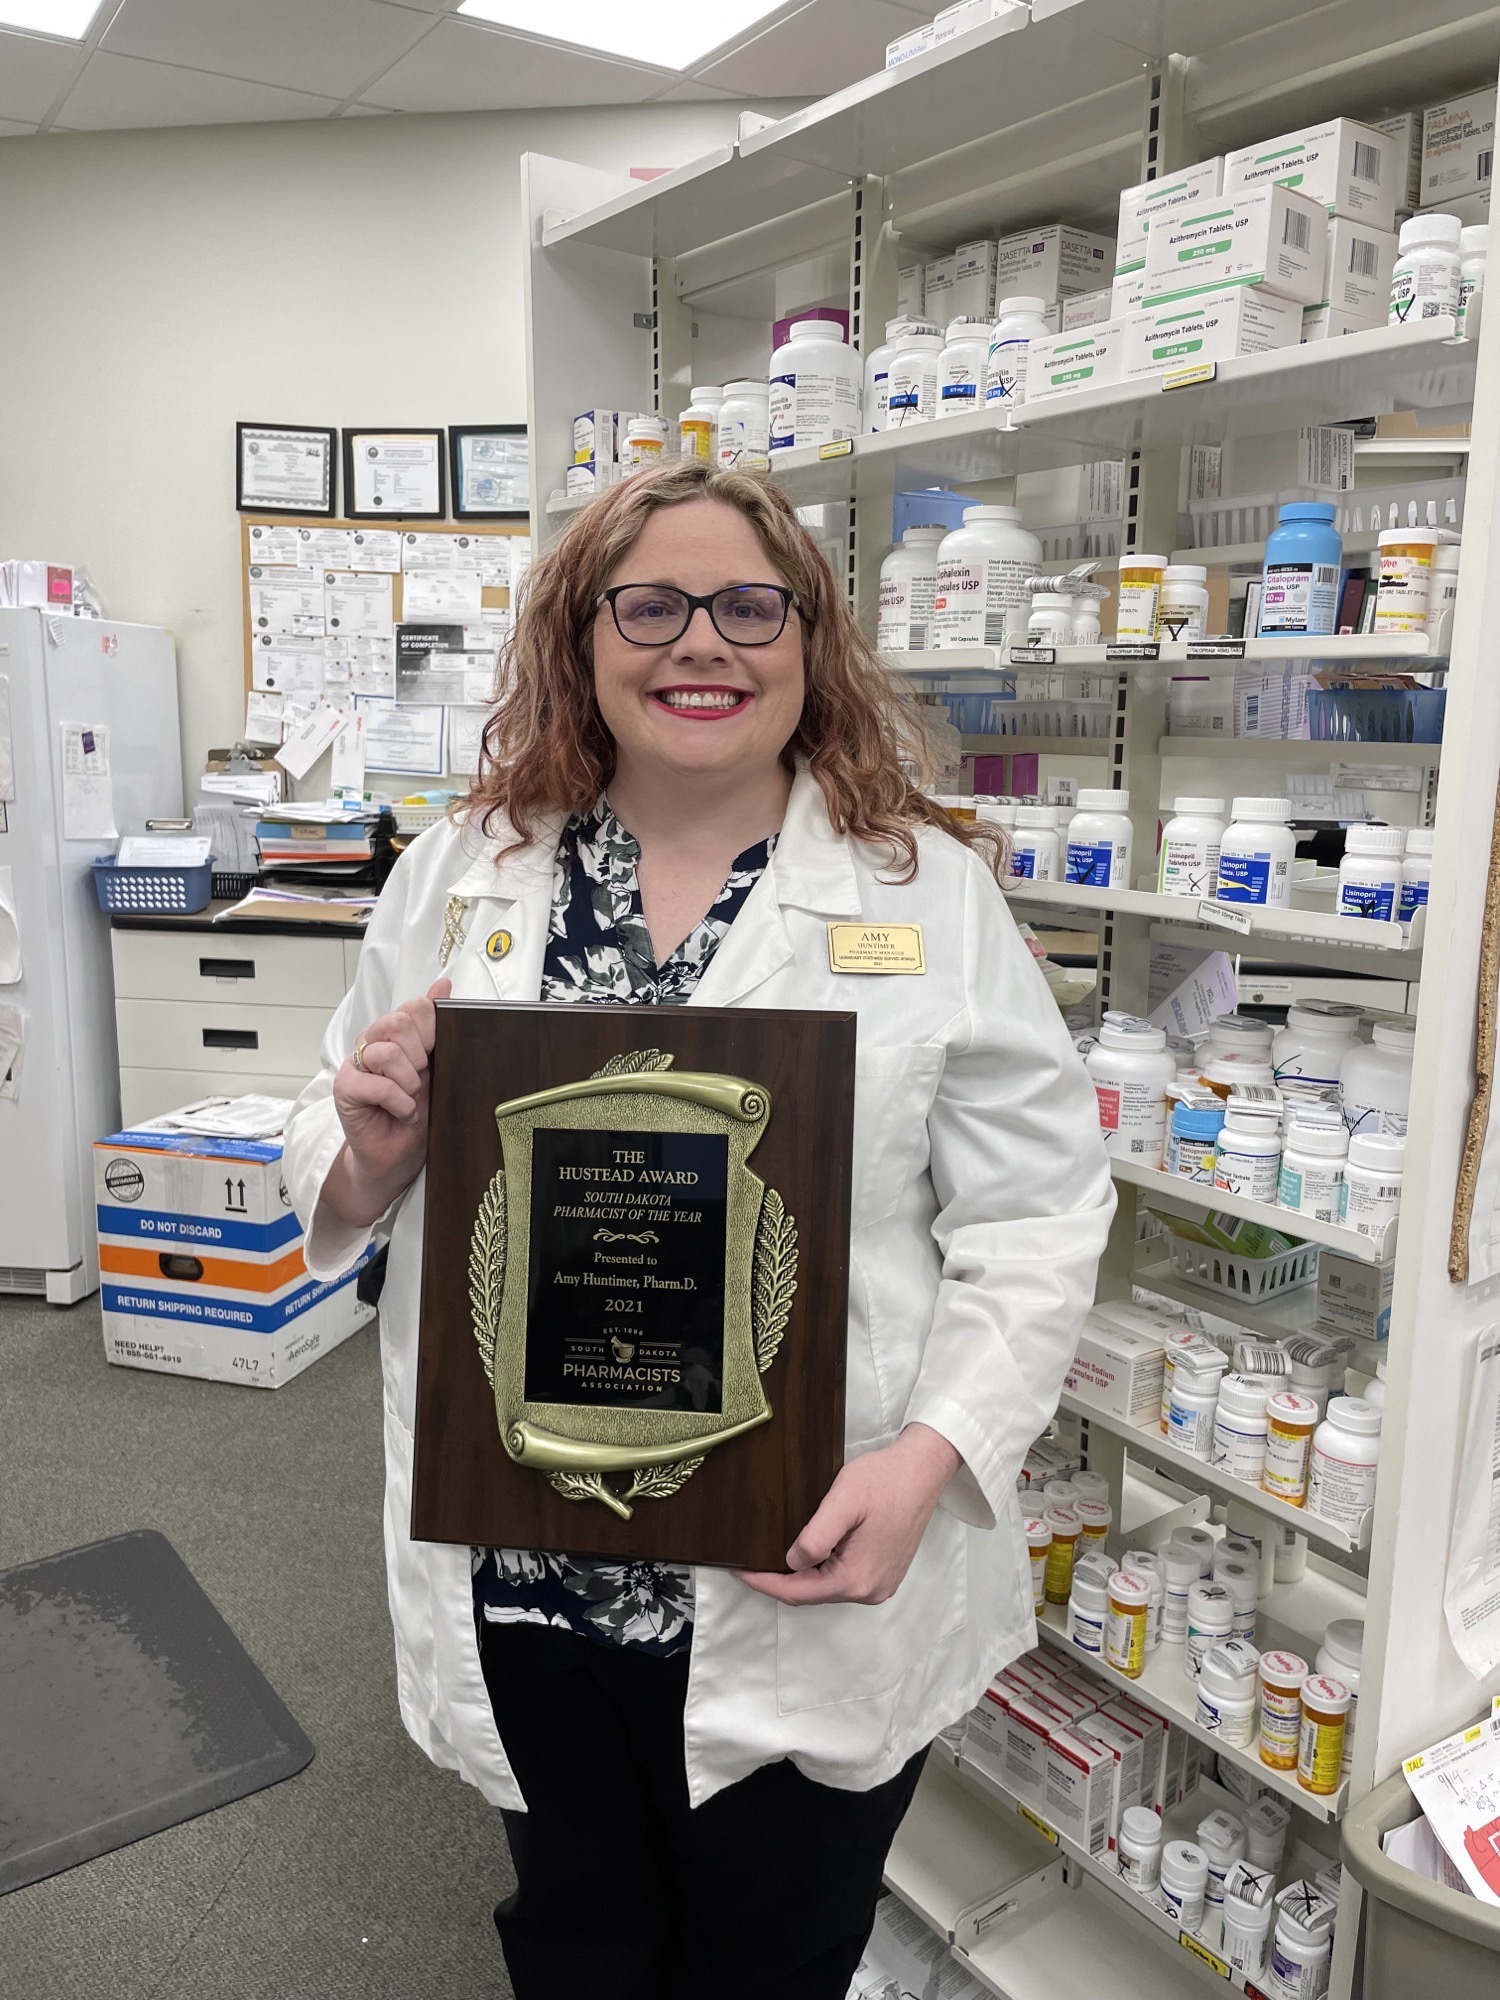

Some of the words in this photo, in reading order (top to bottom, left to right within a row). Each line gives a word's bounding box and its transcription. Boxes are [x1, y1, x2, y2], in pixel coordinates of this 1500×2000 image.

[1427, 110, 1470, 131] FALMINA
[1244, 165, 1280, 181] Azithromycin
[1281, 158, 1305, 170] Tablets,
[1306, 153, 1319, 163] USP
[1136, 202, 1166, 216] Azithromycin
[1188, 190, 1199, 199] USP
[1169, 229, 1207, 244] Azithromycin
[1209, 224, 1233, 234] Tablets,
[1235, 218, 1248, 228] USP
[1000, 246, 1031, 262] DASETTA
[1061, 241, 1092, 256] DASETTA
[1193, 248, 1204, 256] 250
[1398, 288, 1410, 299] USP
[1145, 329, 1180, 343] Azithromycin
[1182, 323, 1204, 335] Tablets,
[1206, 319, 1218, 327] USP
[1166, 347, 1177, 355] 250
[1044, 356, 1074, 369] Azithromycin
[1075, 352, 1094, 362] Tablets,
[1096, 348, 1107, 356] USP
[962, 581, 979, 590] USP
[891, 596, 904, 604] USP
[1221, 861, 1247, 869] Lisinopril
[1345, 889, 1376, 898] Lisinopril
[862, 933, 890, 941] AMY
[613, 1150, 645, 1164] THE
[1180, 1146, 1212, 1154] Metoprolol
[1180, 1152, 1202, 1160] Tartrate
[559, 1167, 634, 1182] HUSTEAD
[638, 1170, 699, 1185] AWARD
[584, 1191, 623, 1204] SOUTH
[626, 1192, 672, 1206] DAKOTA
[553, 1205, 627, 1220] PHARMACIST
[628, 1209, 645, 1221] OF
[648, 1209, 670, 1222] THE
[674, 1211, 702, 1223] YEAR
[140, 1219, 155, 1231] DO
[157, 1220, 177, 1233] NOT
[179, 1224, 222, 1239] DISCARD
[594, 1252, 644, 1265] Presented
[647, 1255, 658, 1265] to
[553, 1271, 580, 1286] Amy
[583, 1273, 640, 1289] Huntimer,
[643, 1275, 697, 1290] Pharm.D.
[118, 1295, 156, 1310] RETURN
[158, 1299, 202, 1316] SHIPPING
[204, 1306, 253, 1323] REQUIRED
[285, 1293, 311, 1316] RETURN
[605, 1299, 644, 1313] 2021
[115, 1340, 136, 1349] NEED
[139, 1343, 164, 1353] HELP?
[288, 1334, 320, 1361] AeroSafe
[571, 1345, 605, 1353] SOUTH
[639, 1349, 677, 1357] DAKOTA
[232, 1357, 259, 1371] 47L7
[563, 1363, 681, 1383] PHARMACISTS
[1091, 1364, 1115, 1380] Sodium
[582, 1381, 663, 1392] ASSOCIATION
[1095, 1377, 1109, 1388] USP
[1408, 1757, 1424, 1773] TALC
